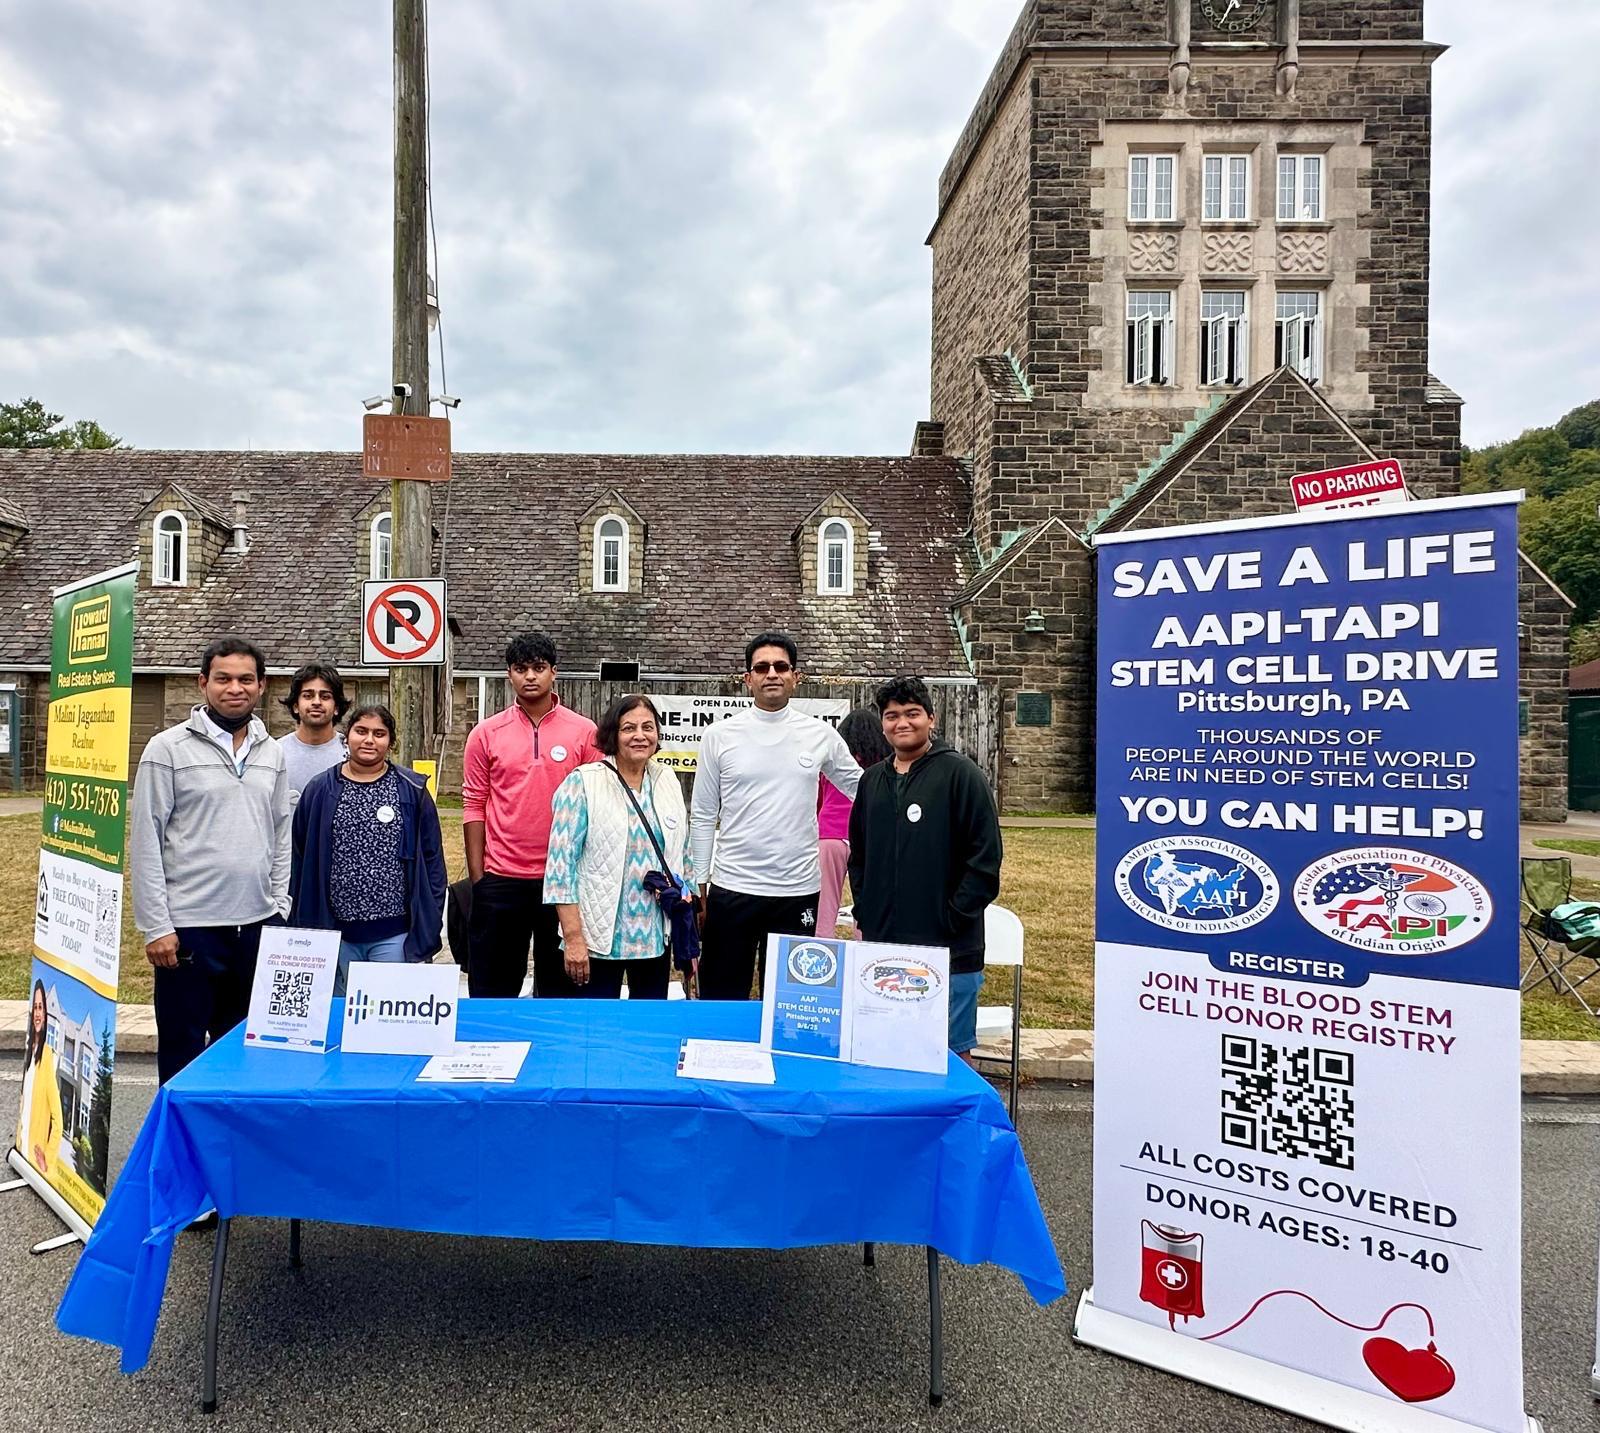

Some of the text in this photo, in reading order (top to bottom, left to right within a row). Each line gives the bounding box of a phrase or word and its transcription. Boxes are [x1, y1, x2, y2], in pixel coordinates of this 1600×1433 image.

[1297, 468, 1398, 500] NO PARKING
[1112, 530, 1496, 598] SAVE A LIFE
[1151, 602, 1440, 649] AAPI-TAPI
[58, 668, 116, 688] Real Estate Services
[1111, 648, 1498, 688] STEM CELL DRIVE
[54, 704, 76, 722] Malini
[724, 700, 754, 708] DAILY
[1178, 688, 1410, 717] Pittsburgh, PA
[1197, 729, 1382, 746] THOUSANDS OF
[1126, 748, 1476, 768] PEOPLE AROUND THE WORLD
[1130, 767, 1469, 790] ARE IN NEED OF STEM CELLS!
[45, 776, 120, 817] (412) 551-7378
[1120, 796, 1484, 840] YOU CAN HELP!
[1124, 838, 1272, 879] AMERICAN ASSOCIATION OF
[1298, 849, 1484, 911] Tristate Association of Physicians
[52, 888, 94, 914] FREE CONSULT
[1120, 882, 1274, 931] PHYSICIANS OF INDIAN ORIGIN
[1192, 890, 1248, 907] AAPI
[55, 911, 68, 926] CALL
[76, 918, 90, 934] TEXT
[1328, 909, 1447, 937] TAPI
[1331, 928, 1446, 952] of Indian Origin
[1229, 951, 1345, 980] REGISTER
[379, 994, 452, 1026] nmdp
[777, 1002, 840, 1016] STEM CELL DRIVE
[1142, 970, 1453, 1029] JOIN THE BLOOD STEM
[1139, 994, 1456, 1055] CELL DONOR REGISTRY
[1139, 1142, 1457, 1228] ALL COSTS COVERED
[1146, 1183, 1449, 1274] DONOR AGES: 18-40
